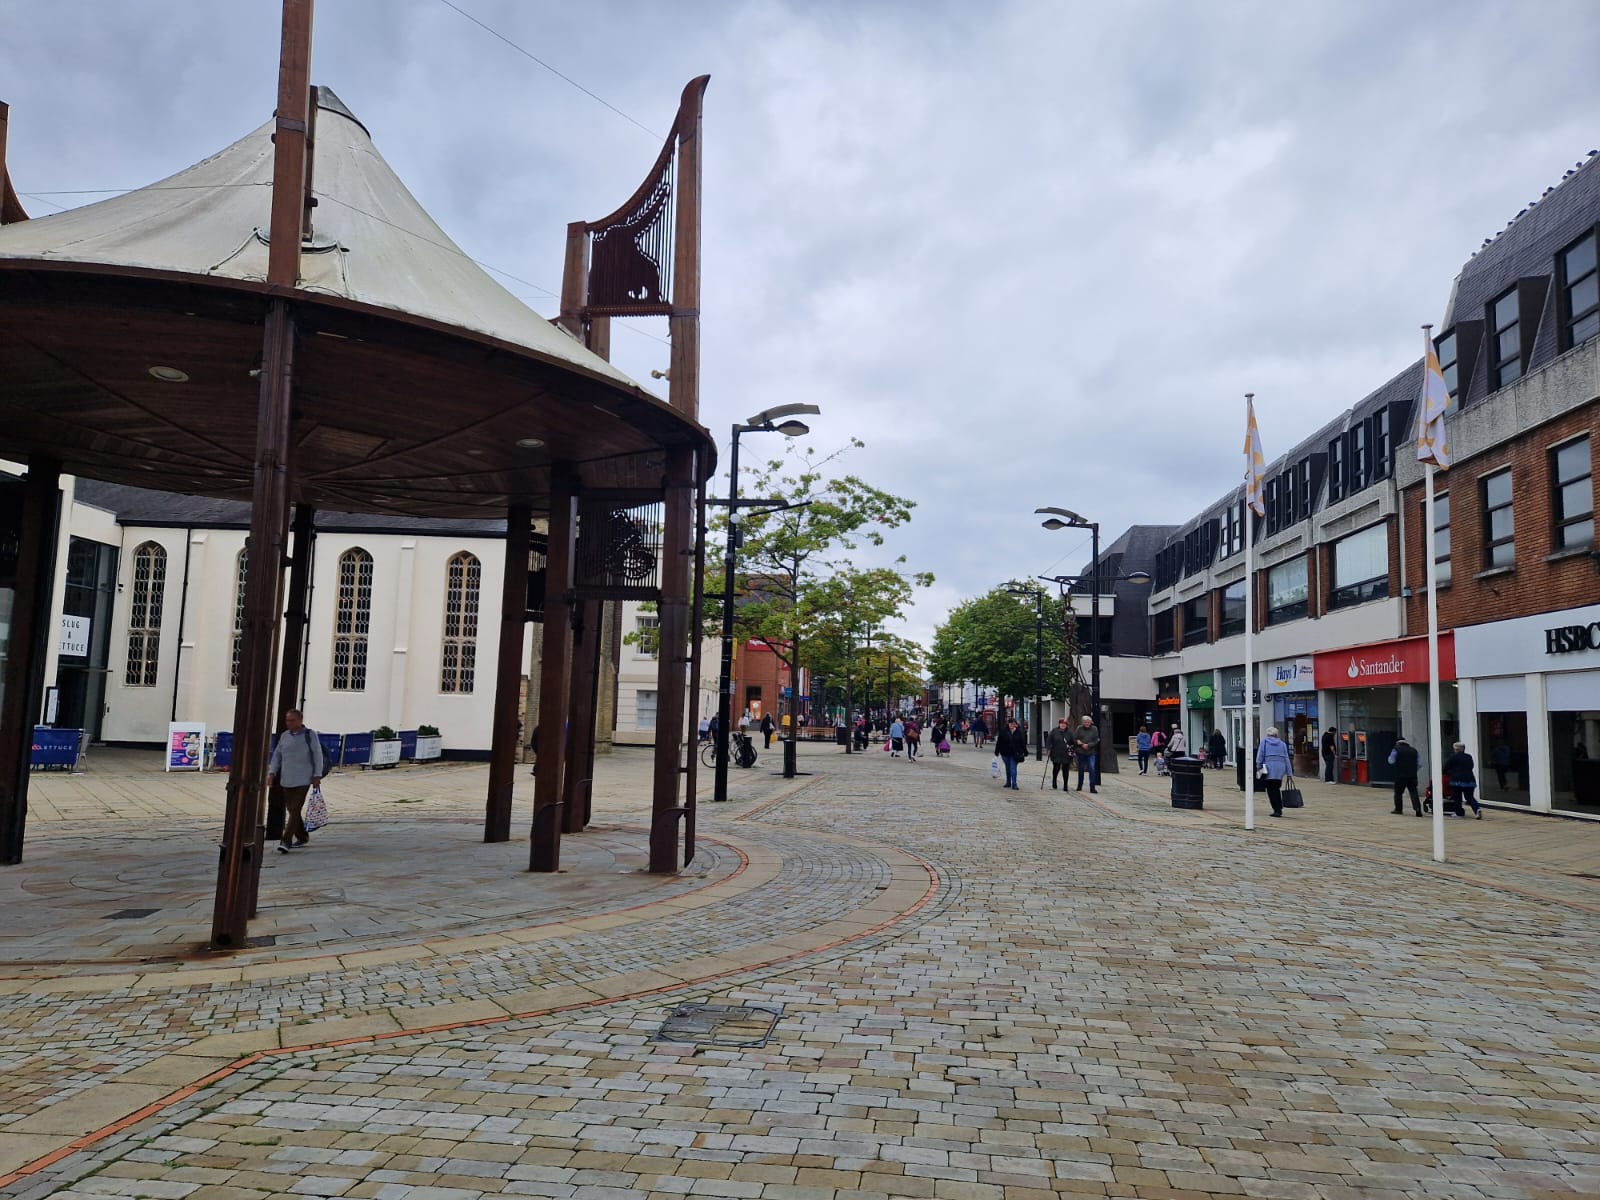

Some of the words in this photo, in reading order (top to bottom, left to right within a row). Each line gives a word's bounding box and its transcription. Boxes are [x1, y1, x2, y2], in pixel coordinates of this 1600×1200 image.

[62, 619, 80, 629] SLUG
[1544, 621, 1600, 654] HSBC
[59, 642, 85, 652] TTUCE
[1276, 665, 1291, 683] Hays
[1360, 654, 1405, 676] Santander
